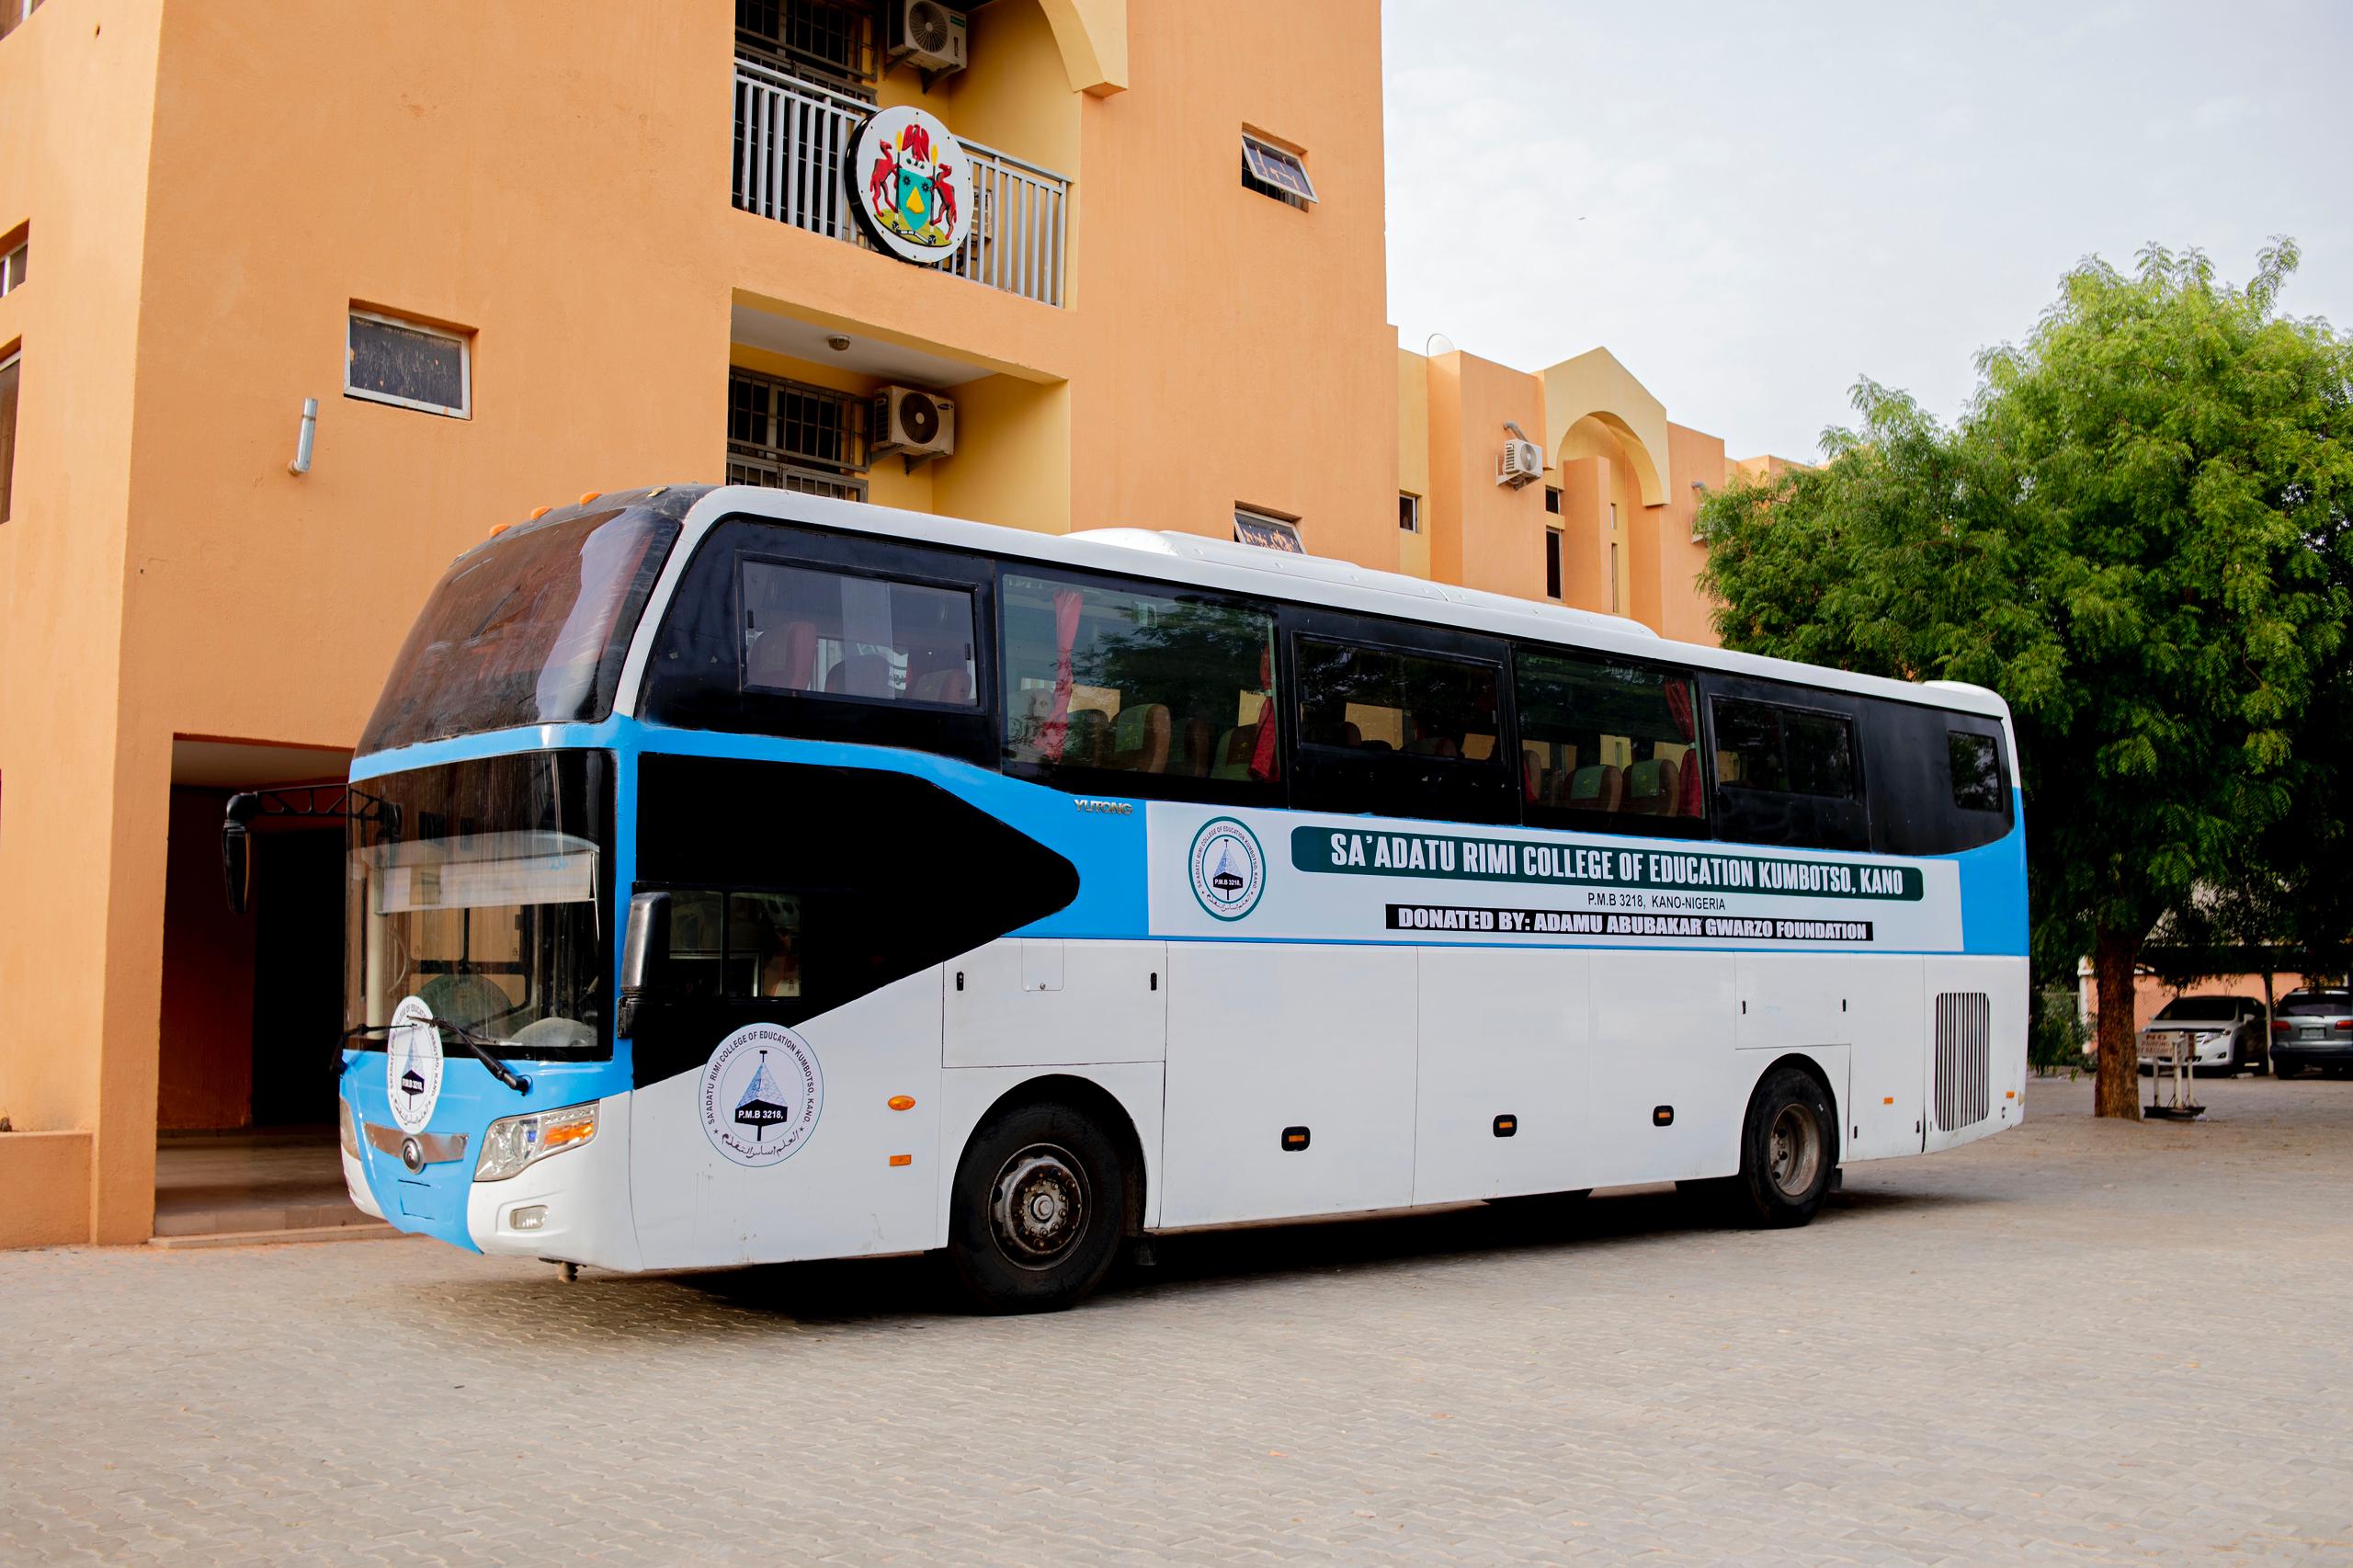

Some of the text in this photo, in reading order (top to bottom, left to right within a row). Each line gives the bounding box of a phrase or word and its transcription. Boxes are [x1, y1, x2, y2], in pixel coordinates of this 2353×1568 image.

[1074, 799, 1133, 815] YUTONG
[1200, 829, 1216, 846] COLLEGE
[1222, 825, 1245, 841] EDUCATION
[1462, 841, 1517, 875] RIMI
[1522, 846, 1614, 881] COLLEGE
[1619, 852, 1643, 881] OF
[1649, 855, 1754, 888] EDUCATION
[1758, 861, 1857, 895] KUMBOTSO,
[1859, 868, 1904, 895] KANO
[1228, 879, 1242, 887] 3218,
[1587, 892, 1726, 911] P.M.B 3218, KANO-NIGERIA
[1398, 907, 1867, 939] DONATED BY: ADAMU ABUBAKAR GWARZO FOUNDATION
[748, 1031, 757, 1040] OF
[759, 1030, 797, 1052] EDUCATION
[719, 1034, 747, 1062] COLLEGE
[710, 1062, 722, 1082] RIMI
[794, 1049, 814, 1096] KUMBOTSO,
[706, 1083, 715, 1125] SA'ADATU
[738, 1110, 784, 1120] P.M.B 3218,
